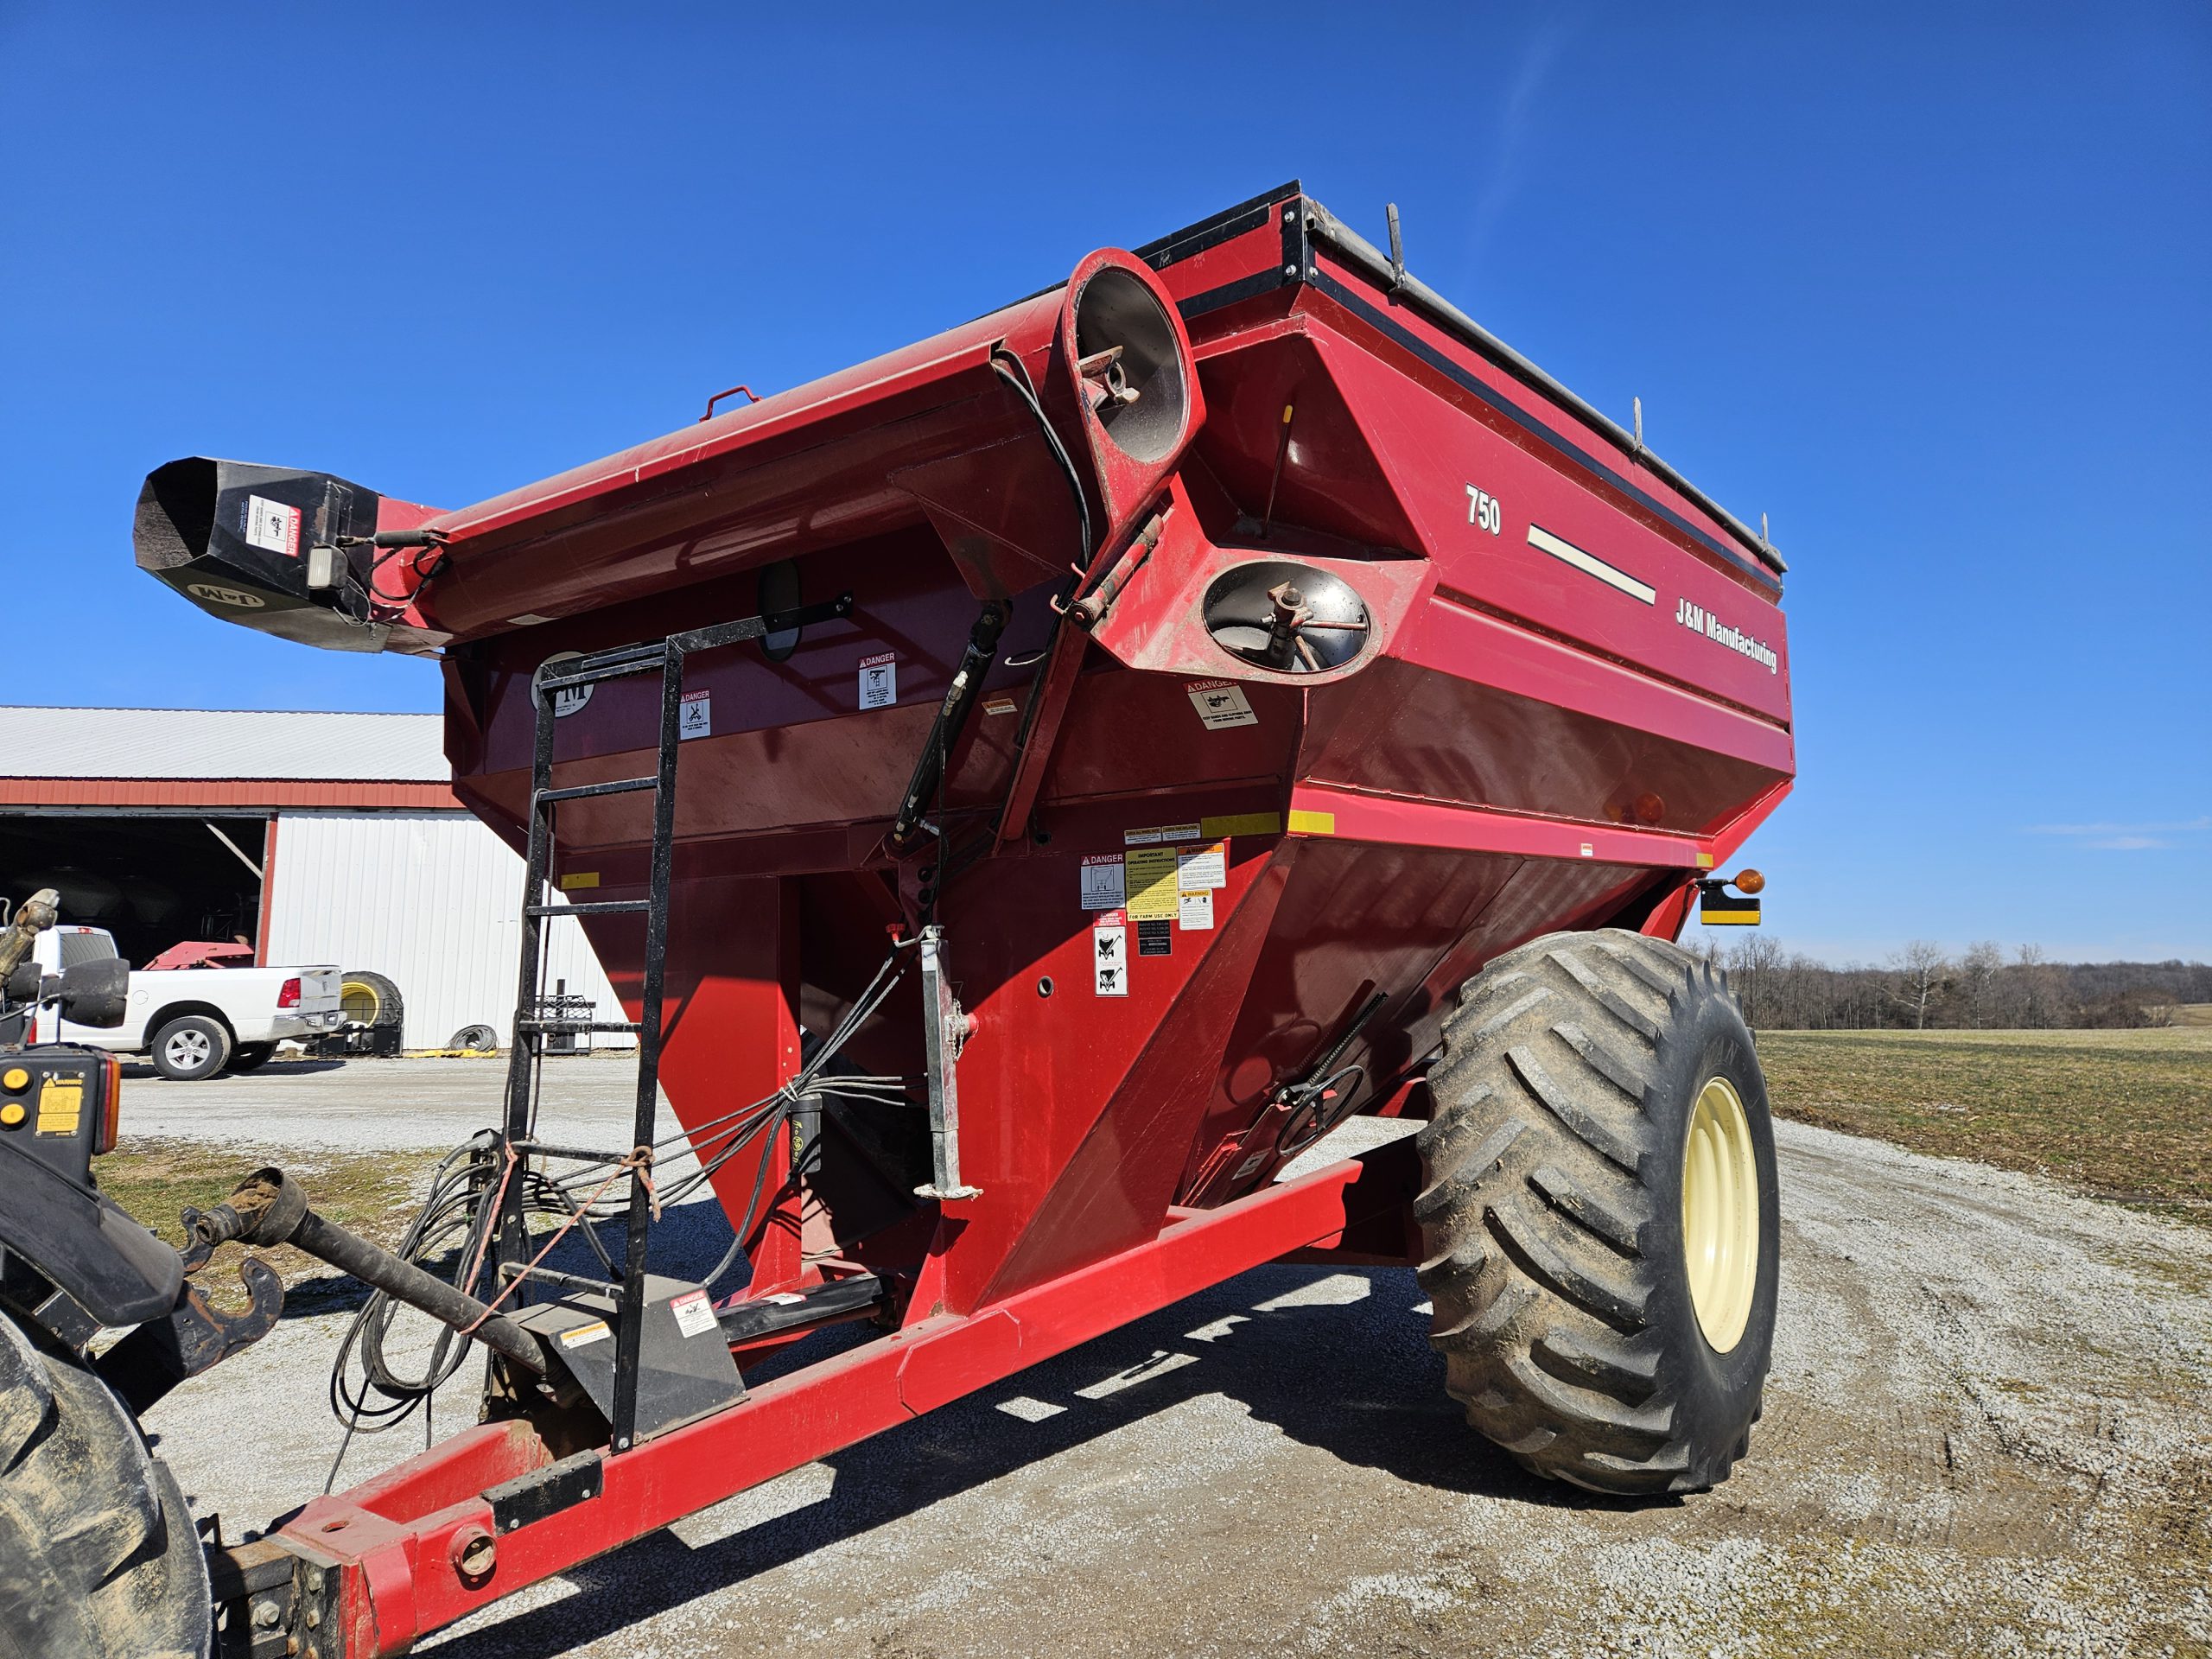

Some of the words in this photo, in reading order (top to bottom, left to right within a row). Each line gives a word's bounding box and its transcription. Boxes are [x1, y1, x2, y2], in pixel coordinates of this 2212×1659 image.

[1465, 481, 1501, 537] 750
[287, 518, 298, 554] DANGER
[196, 587, 258, 605] J&M
[1675, 596, 1704, 635] J&M
[1706, 610, 1777, 676] Manufacturing
[866, 652, 894, 665] DANGER
[685, 690, 709, 702] DANGER
[1091, 854, 1123, 864] DANGER
